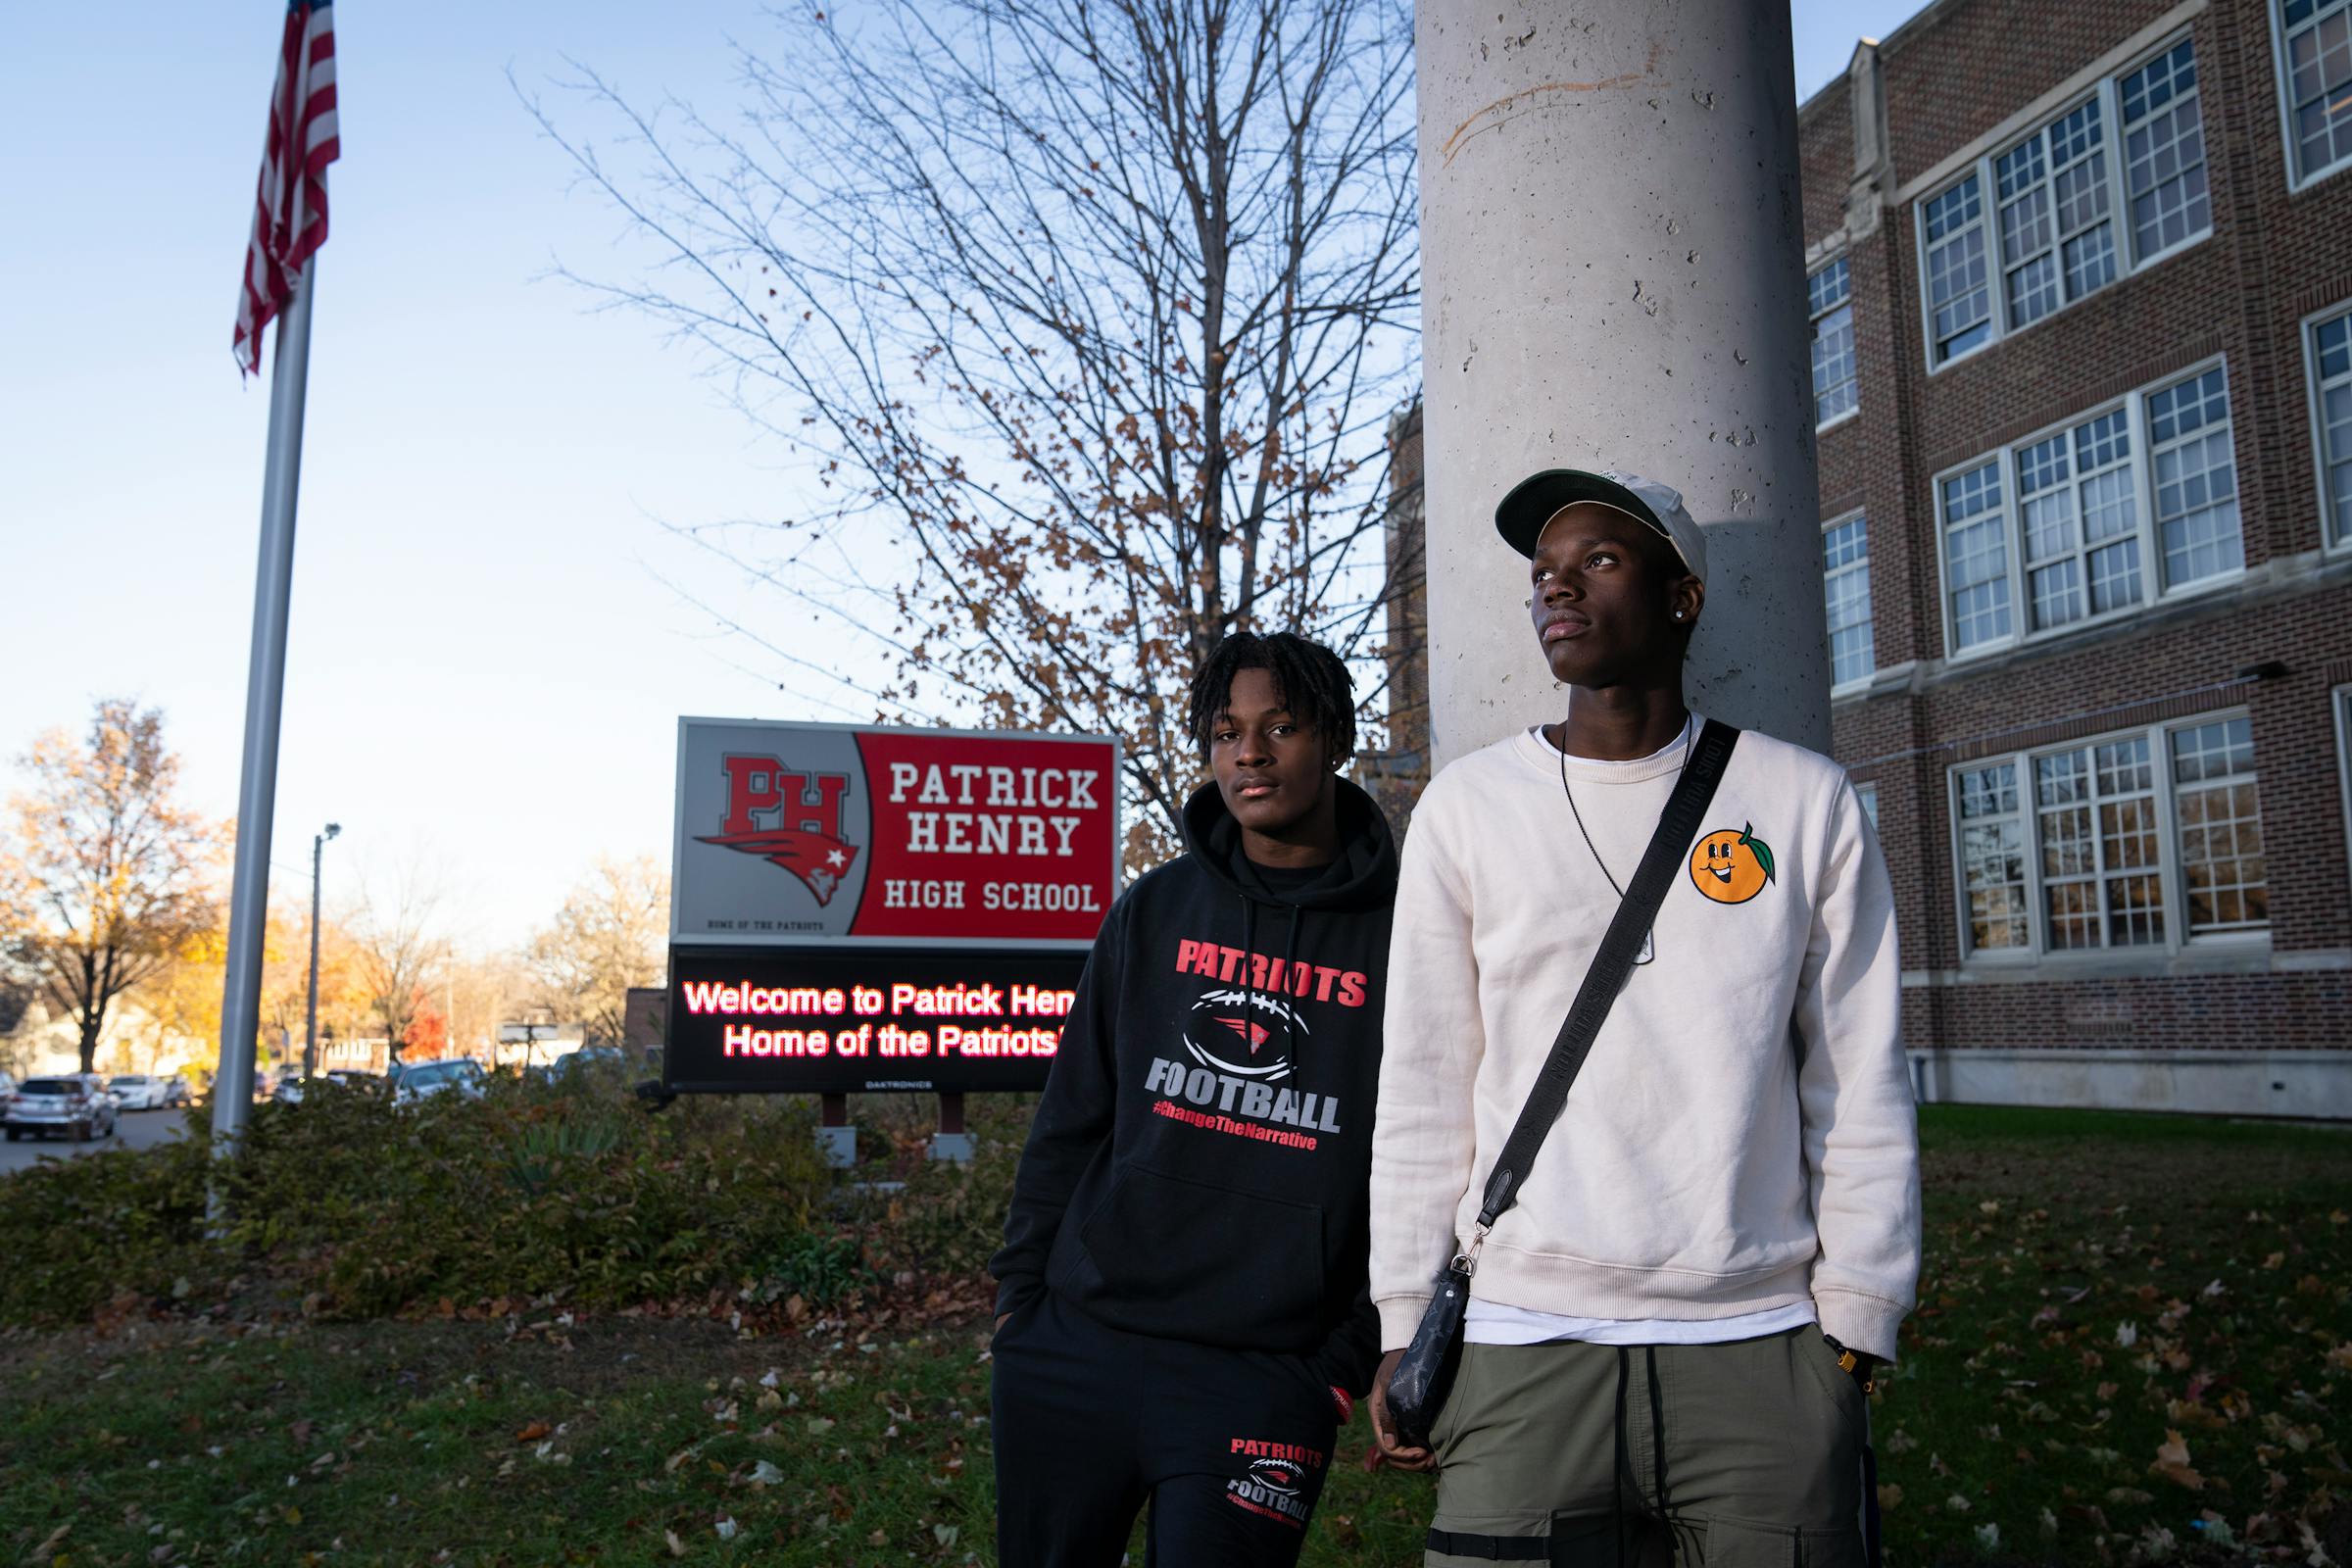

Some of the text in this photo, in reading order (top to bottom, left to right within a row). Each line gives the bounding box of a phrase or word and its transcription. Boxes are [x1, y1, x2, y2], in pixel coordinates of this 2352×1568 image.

[889, 762, 1099, 809] PATRICK
[906, 811, 1081, 857] HENRY
[884, 880, 1101, 912] HIGH SCHOOL
[708, 920, 823, 931] HOME OF THE PATRIOTS
[1176, 938, 1368, 1008] PATRIOTS
[683, 981, 845, 1015] Welcome
[852, 983, 884, 1015] to
[891, 983, 1004, 1016] Patrick
[723, 1024, 829, 1057] Home
[835, 1024, 871, 1057] of
[878, 1024, 930, 1057] the
[1144, 1056, 1342, 1134] FOOTBALL
[1152, 1100, 1318, 1152] #ChangeTheNarrative
[1231, 1439, 1323, 1468] PATRIOTS
[1226, 1479, 1308, 1522] FOOTBALL
